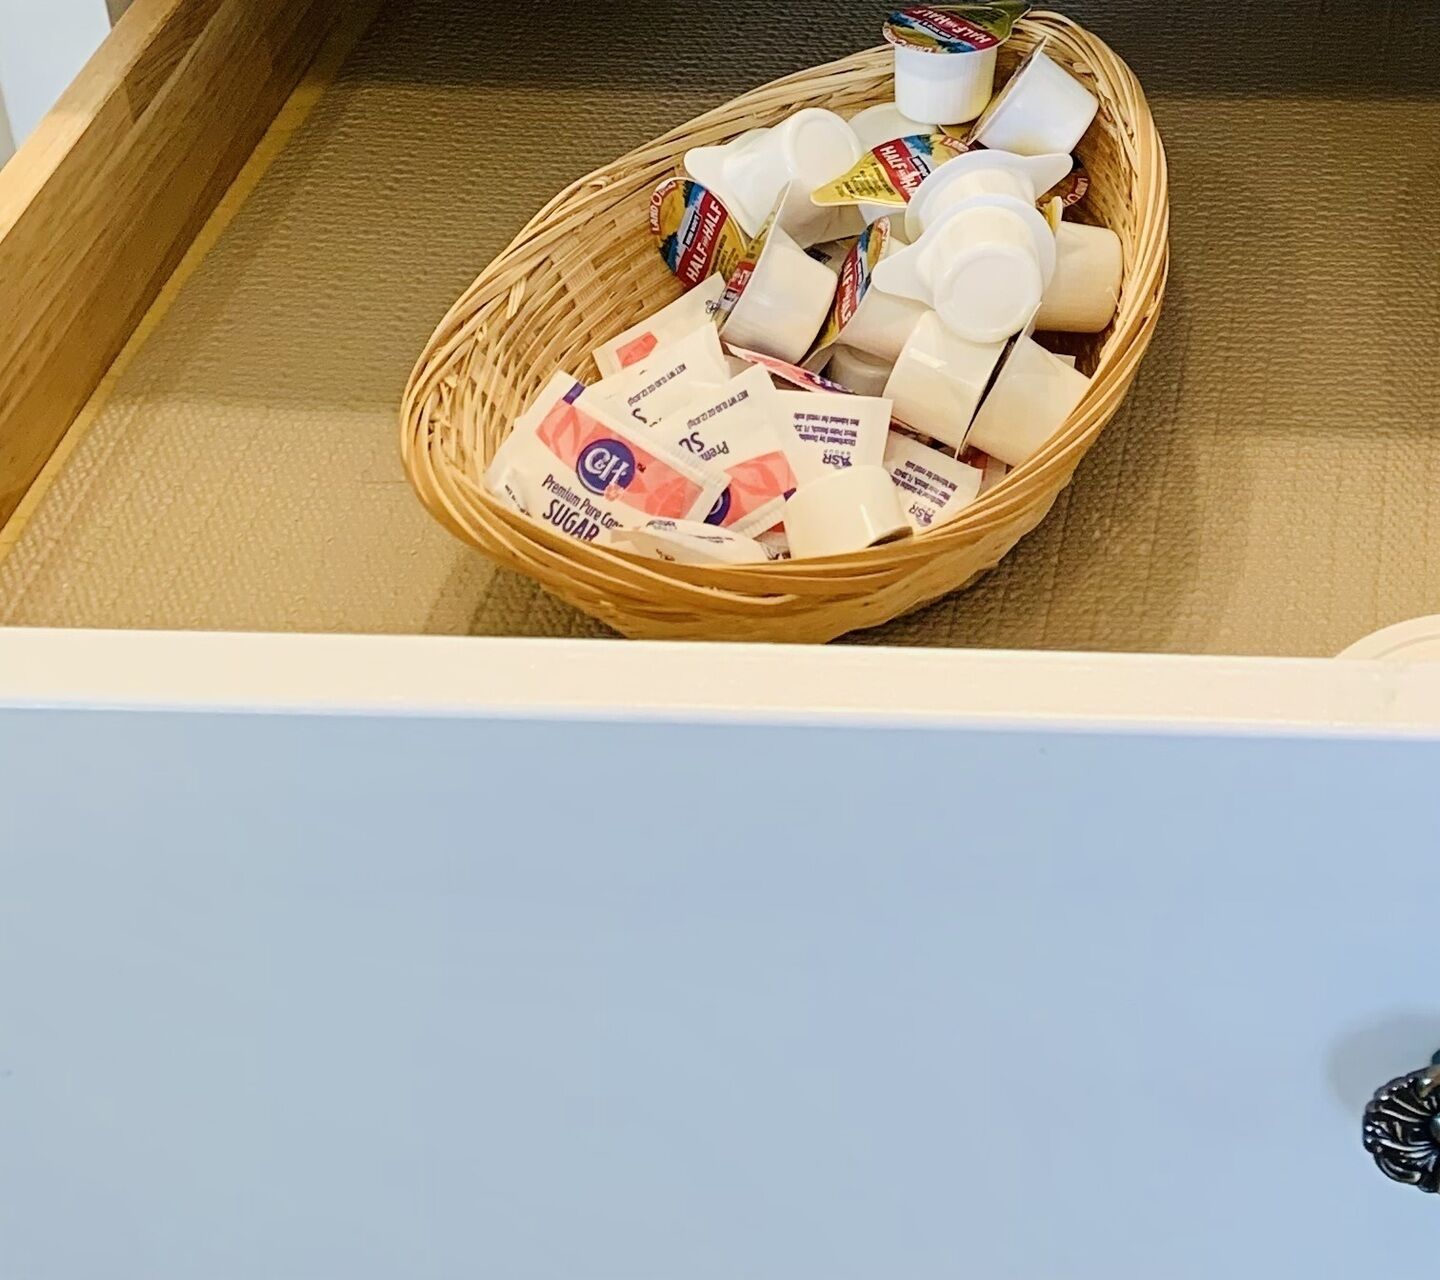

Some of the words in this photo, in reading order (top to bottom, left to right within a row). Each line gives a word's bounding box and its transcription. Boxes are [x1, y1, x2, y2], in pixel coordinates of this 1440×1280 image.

[880, 145, 903, 169] HALF
[686, 242, 707, 282] HALF
[705, 200, 722, 240] HALF
[700, 441, 730, 461] Prem
[822, 453, 852, 466] ASR
[541, 473, 579, 506] Premium
[579, 497, 602, 521] Pure
[542, 499, 600, 541] SUGAR
[909, 504, 935, 525] ASR
